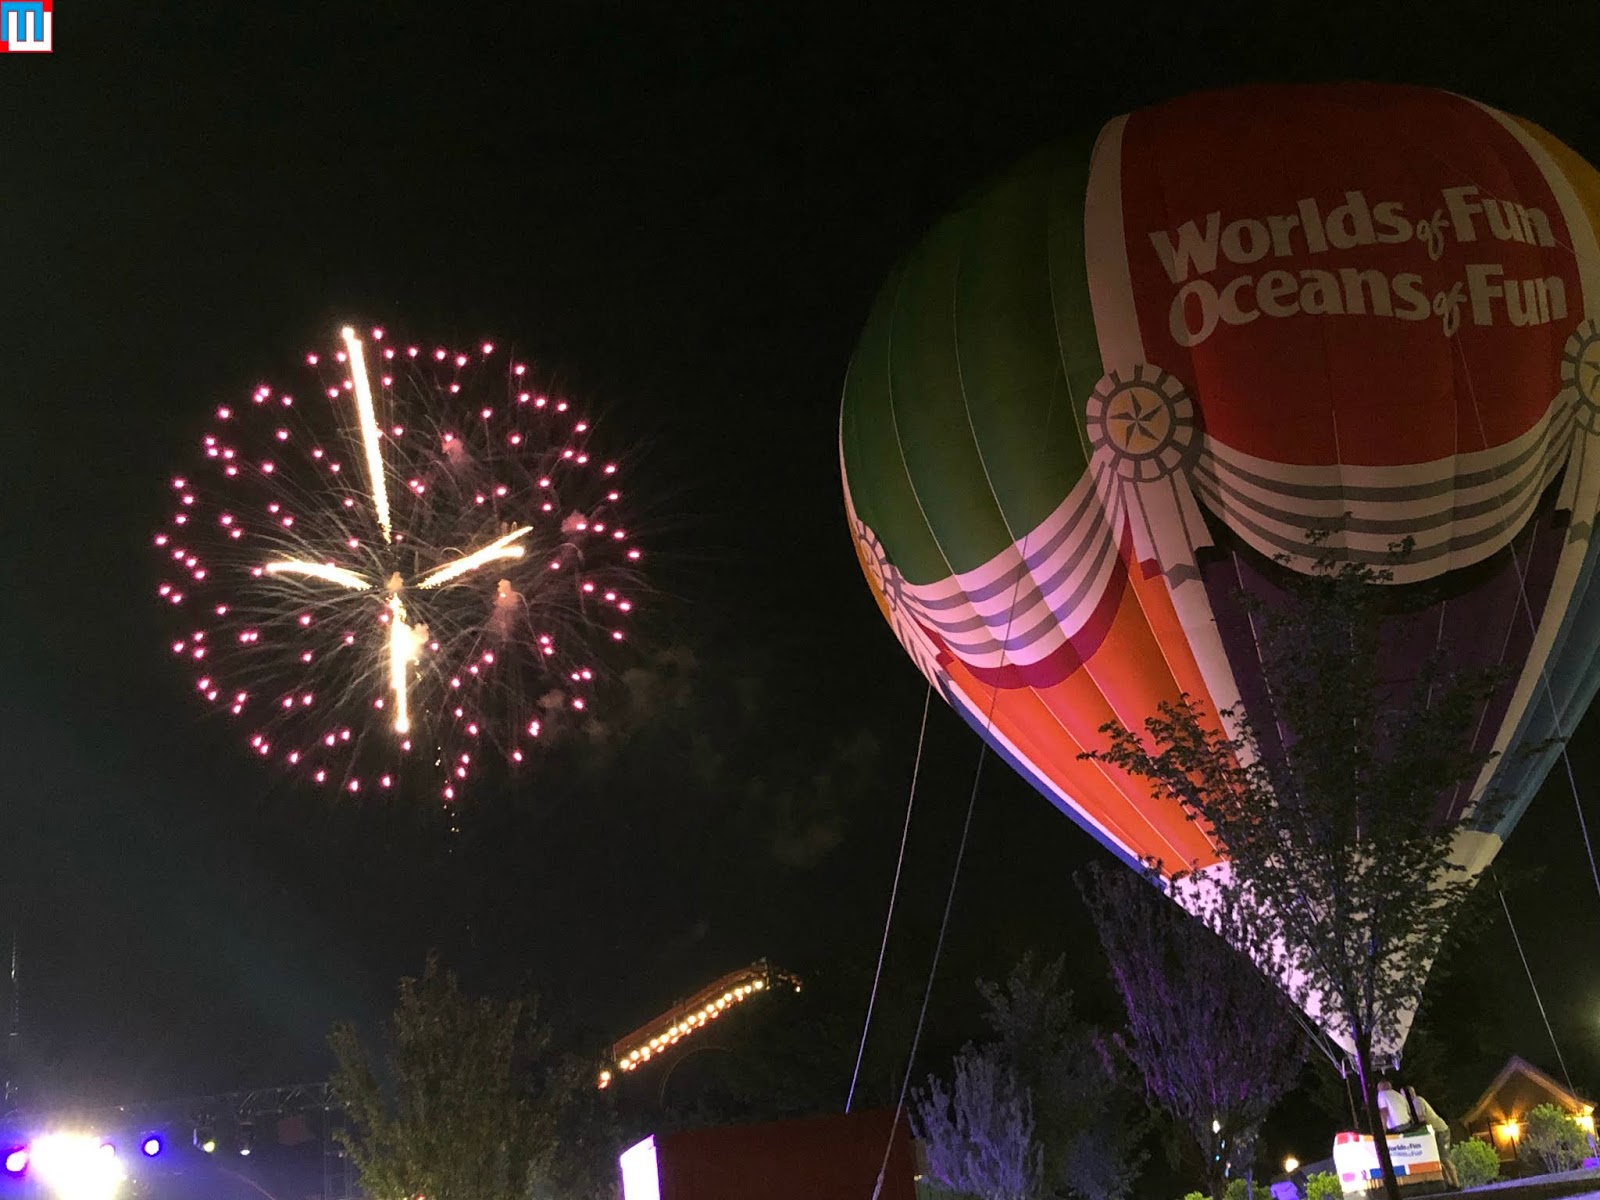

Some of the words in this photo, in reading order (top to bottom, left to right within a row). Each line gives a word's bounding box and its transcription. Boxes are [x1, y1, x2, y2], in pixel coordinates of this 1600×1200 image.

[1149, 190, 1413, 283] Worlds
[1416, 208, 1449, 261] of
[1442, 186, 1555, 247] Fun
[1169, 267, 1431, 347] Oceans
[1432, 281, 1467, 337] of
[1466, 263, 1567, 327] Fun
